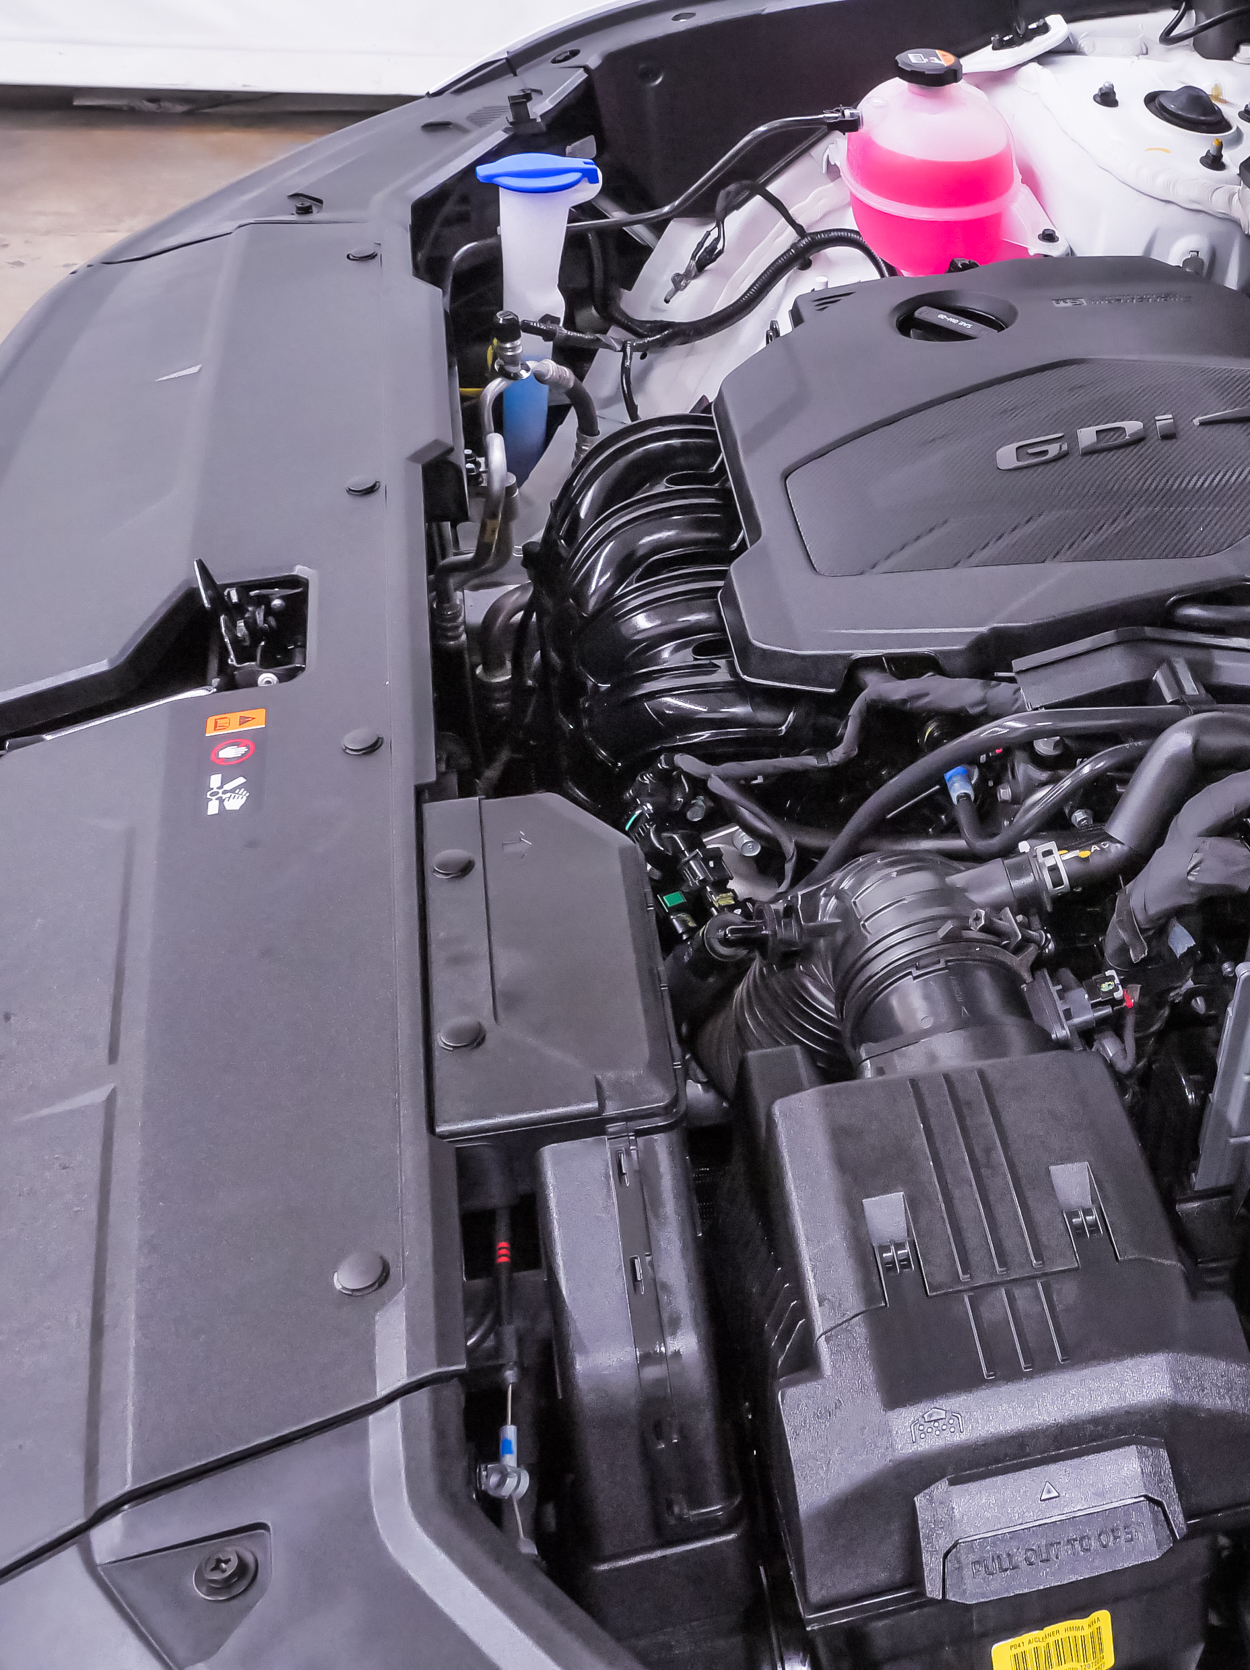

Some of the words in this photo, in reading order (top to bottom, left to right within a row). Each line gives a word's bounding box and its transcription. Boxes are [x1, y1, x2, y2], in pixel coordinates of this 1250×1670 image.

[970, 1552, 1020, 1578] PULL
[1025, 1541, 1061, 1566] OUT
[1067, 1535, 1092, 1552] TO
[1098, 1526, 1140, 1548] OPE
